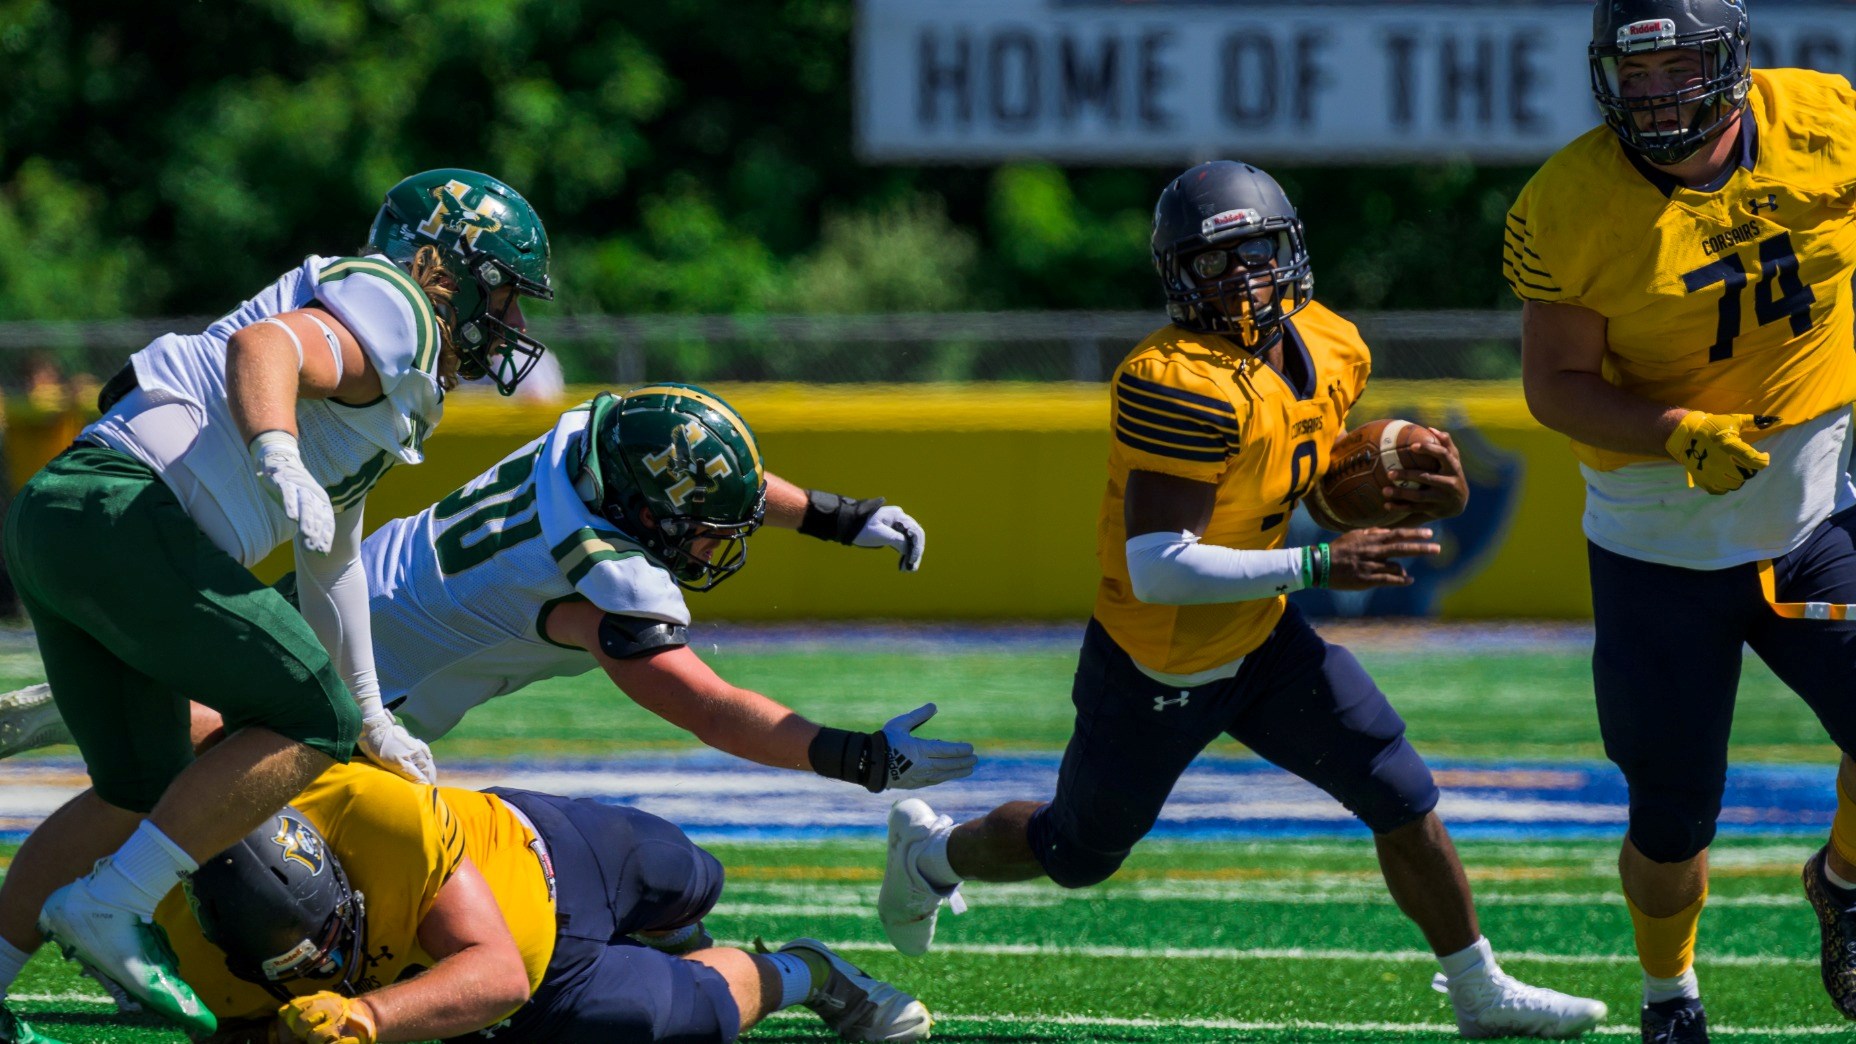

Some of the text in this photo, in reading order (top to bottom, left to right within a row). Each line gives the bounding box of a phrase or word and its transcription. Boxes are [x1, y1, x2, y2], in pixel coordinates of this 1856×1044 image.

[1629, 21, 1662, 35] Riddell
[915, 27, 1553, 132] HOME OF THE
[1702, 219, 1760, 257] CORSAIRS
[1682, 231, 1817, 363] 74
